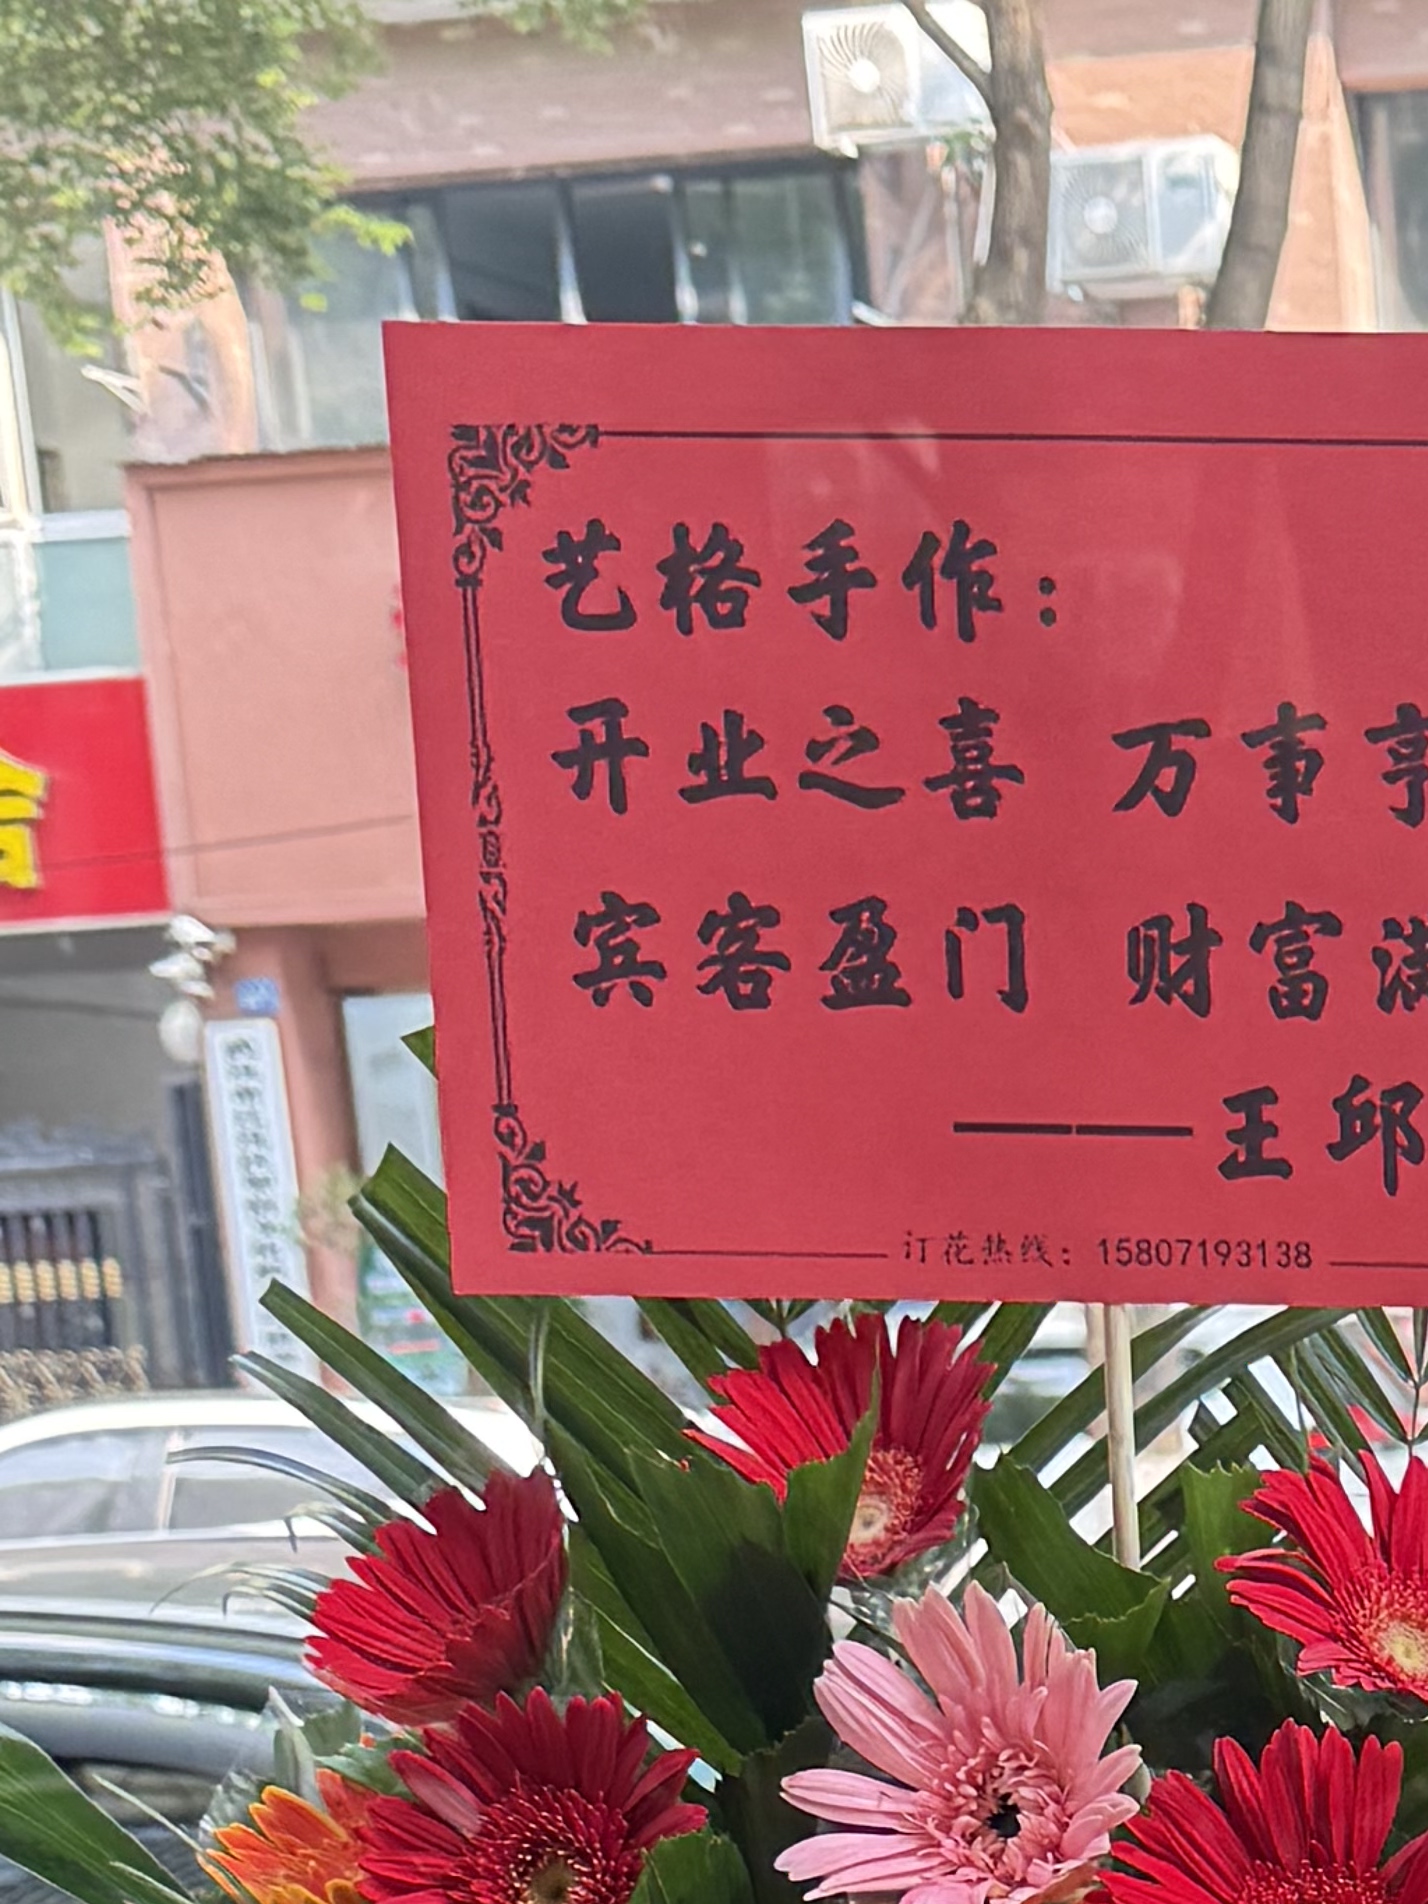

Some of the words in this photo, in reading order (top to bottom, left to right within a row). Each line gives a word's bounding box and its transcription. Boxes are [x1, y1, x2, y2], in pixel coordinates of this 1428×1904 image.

[541, 518, 1058, 643] 艺格手作：
[550, 696, 1025, 820] 开业之喜
[572, 891, 1029, 1014] 宾客盈门
[1098, 1237, 1313, 1270] 15807193138
